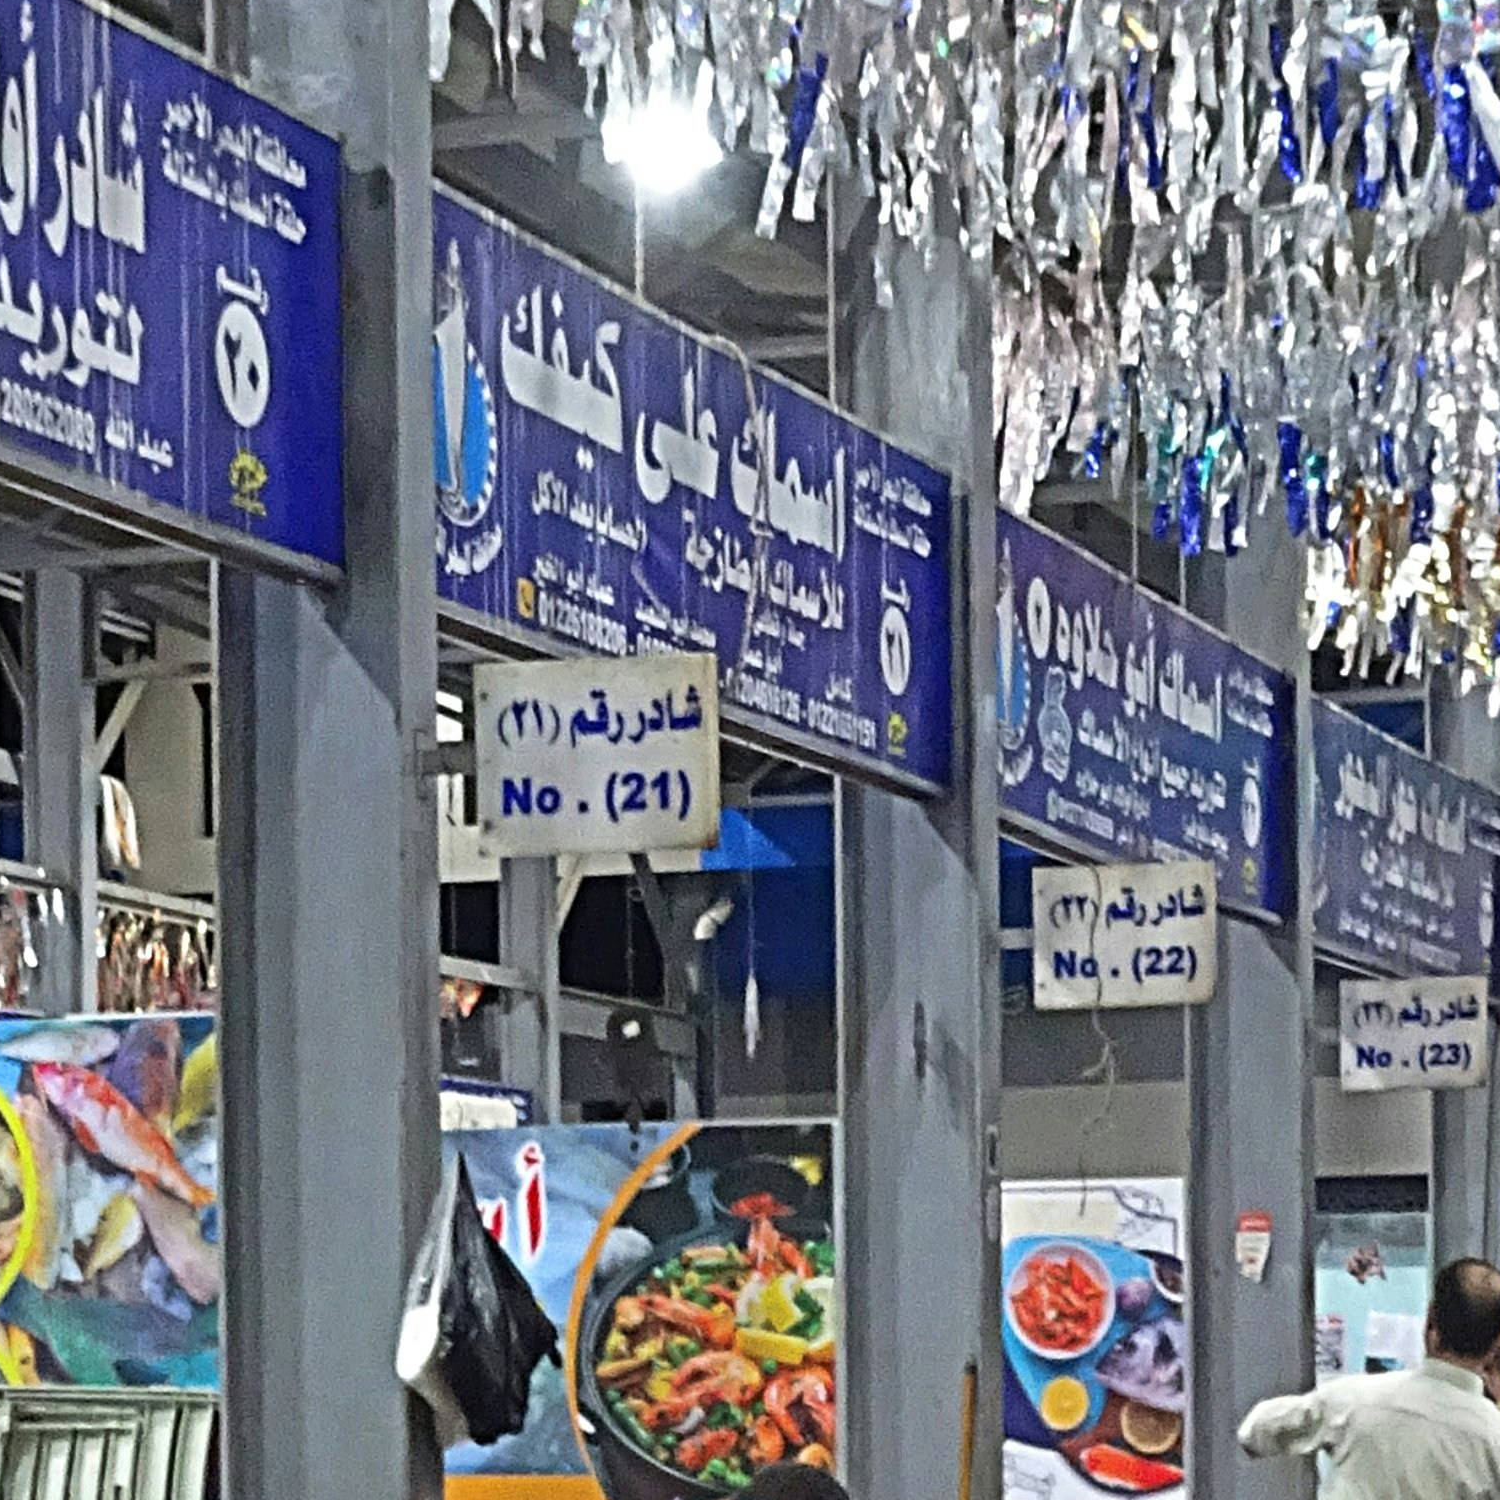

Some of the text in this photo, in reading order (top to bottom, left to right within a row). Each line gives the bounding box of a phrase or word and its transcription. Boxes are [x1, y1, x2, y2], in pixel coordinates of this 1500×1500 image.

[43, 87, 146, 256] شادر
[222, 329, 261, 394] ٢٠
[498, 283, 626, 472] كيفك
[104, 410, 175, 476] عبد الله
[634, 366, 721, 505] على
[497, 683, 702, 749] شادر رقم (٢١)
[605, 768, 691, 824] (21)
[1105, 886, 1147, 930] رقم
[1150, 883, 1207, 927] شادر
[1131, 944, 1198, 986] (22)
[1397, 994, 1432, 1029] رقم
[1435, 993, 1479, 1027] شادر
[1418, 1042, 1472, 1073] (23)
